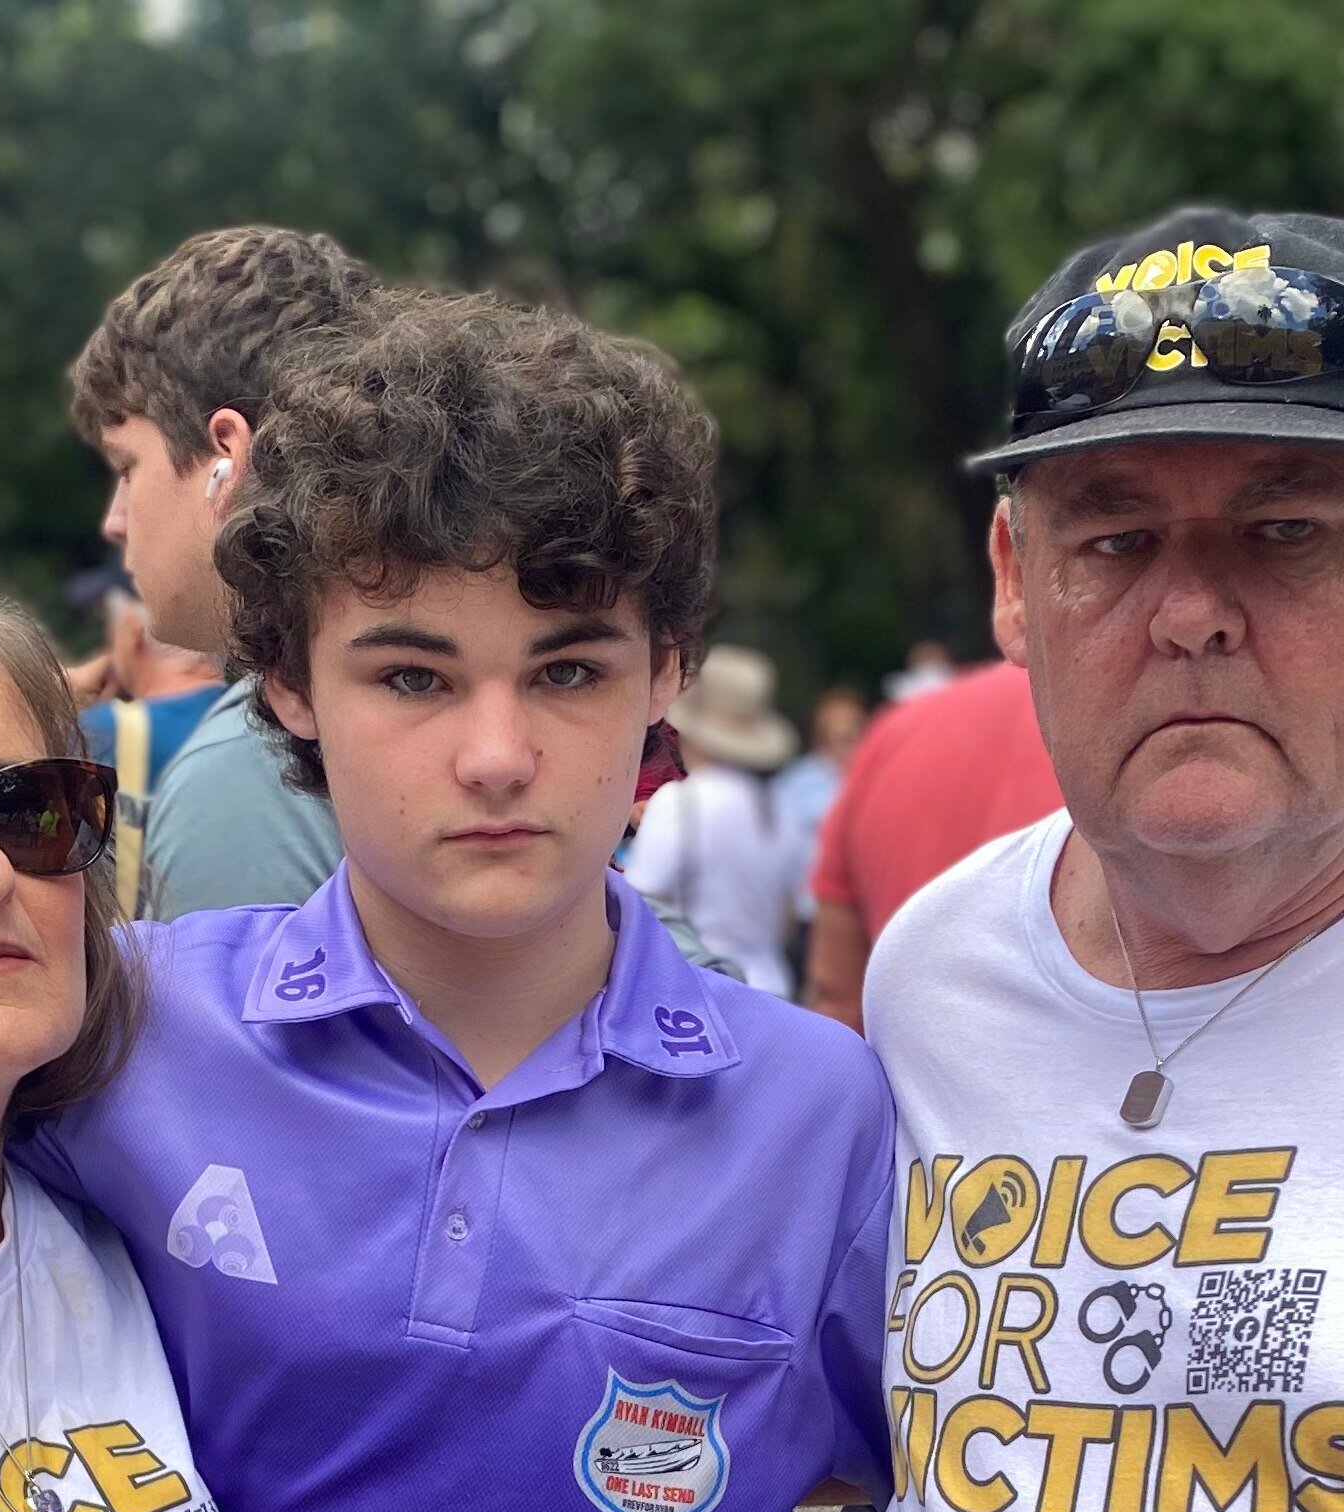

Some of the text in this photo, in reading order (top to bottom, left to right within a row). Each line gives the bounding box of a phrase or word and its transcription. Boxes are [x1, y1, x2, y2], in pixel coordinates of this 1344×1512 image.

[1095, 240, 1271, 293] VOICE
[274, 945, 327, 1002] 16
[653, 1005, 714, 1058] 16
[905, 1146, 1298, 1269] VOICE
[887, 1269, 1057, 1394] FOR
[614, 1399, 705, 1437] RYAN KIMBALL
[605, 1475, 695, 1504] ONE LAST SEND
